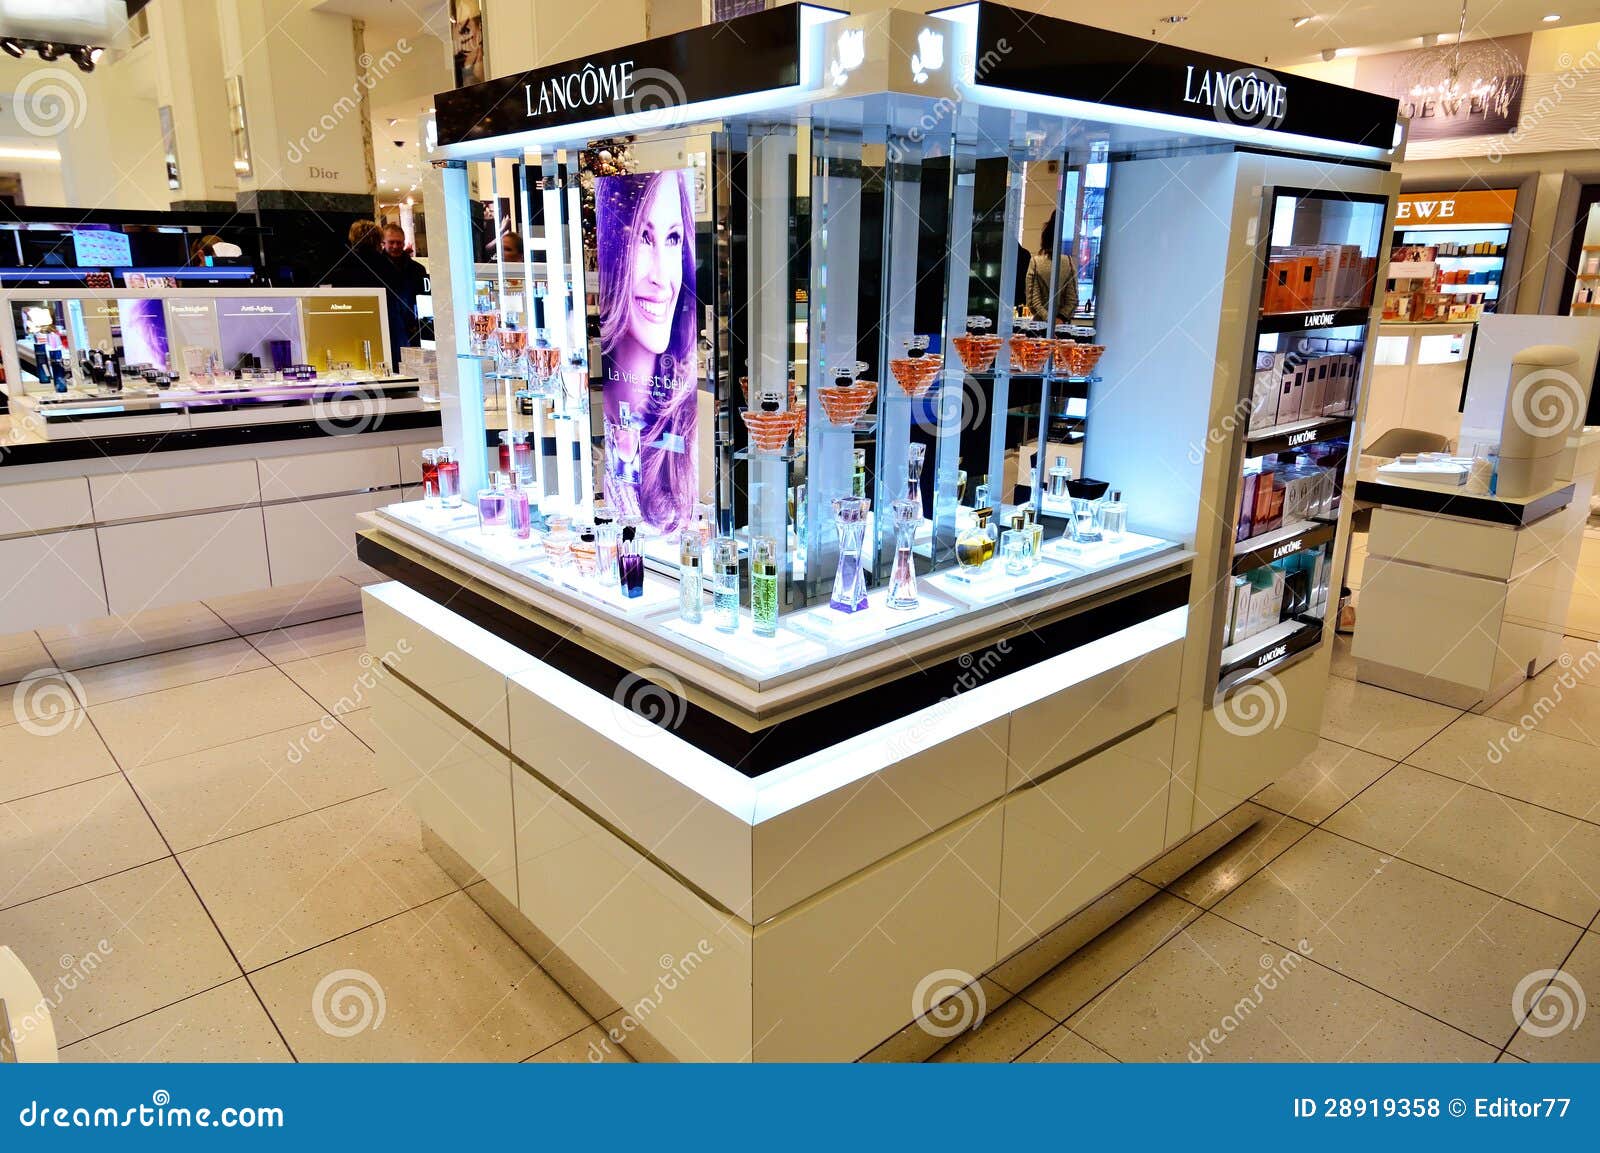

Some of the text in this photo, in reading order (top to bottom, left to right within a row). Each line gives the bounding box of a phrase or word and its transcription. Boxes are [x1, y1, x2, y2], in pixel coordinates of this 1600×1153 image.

[525, 61, 635, 117] LANCÔME
[1183, 65, 1287, 118] LANCÔME
[308, 166, 340, 180] Dior
[240, 304, 274, 313] Anti-Aging
[1304, 312, 1335, 327] LANCÔME
[608, 367, 620, 381] La
[622, 370, 638, 384] vie
[1288, 430, 1318, 446] LANCÔME
